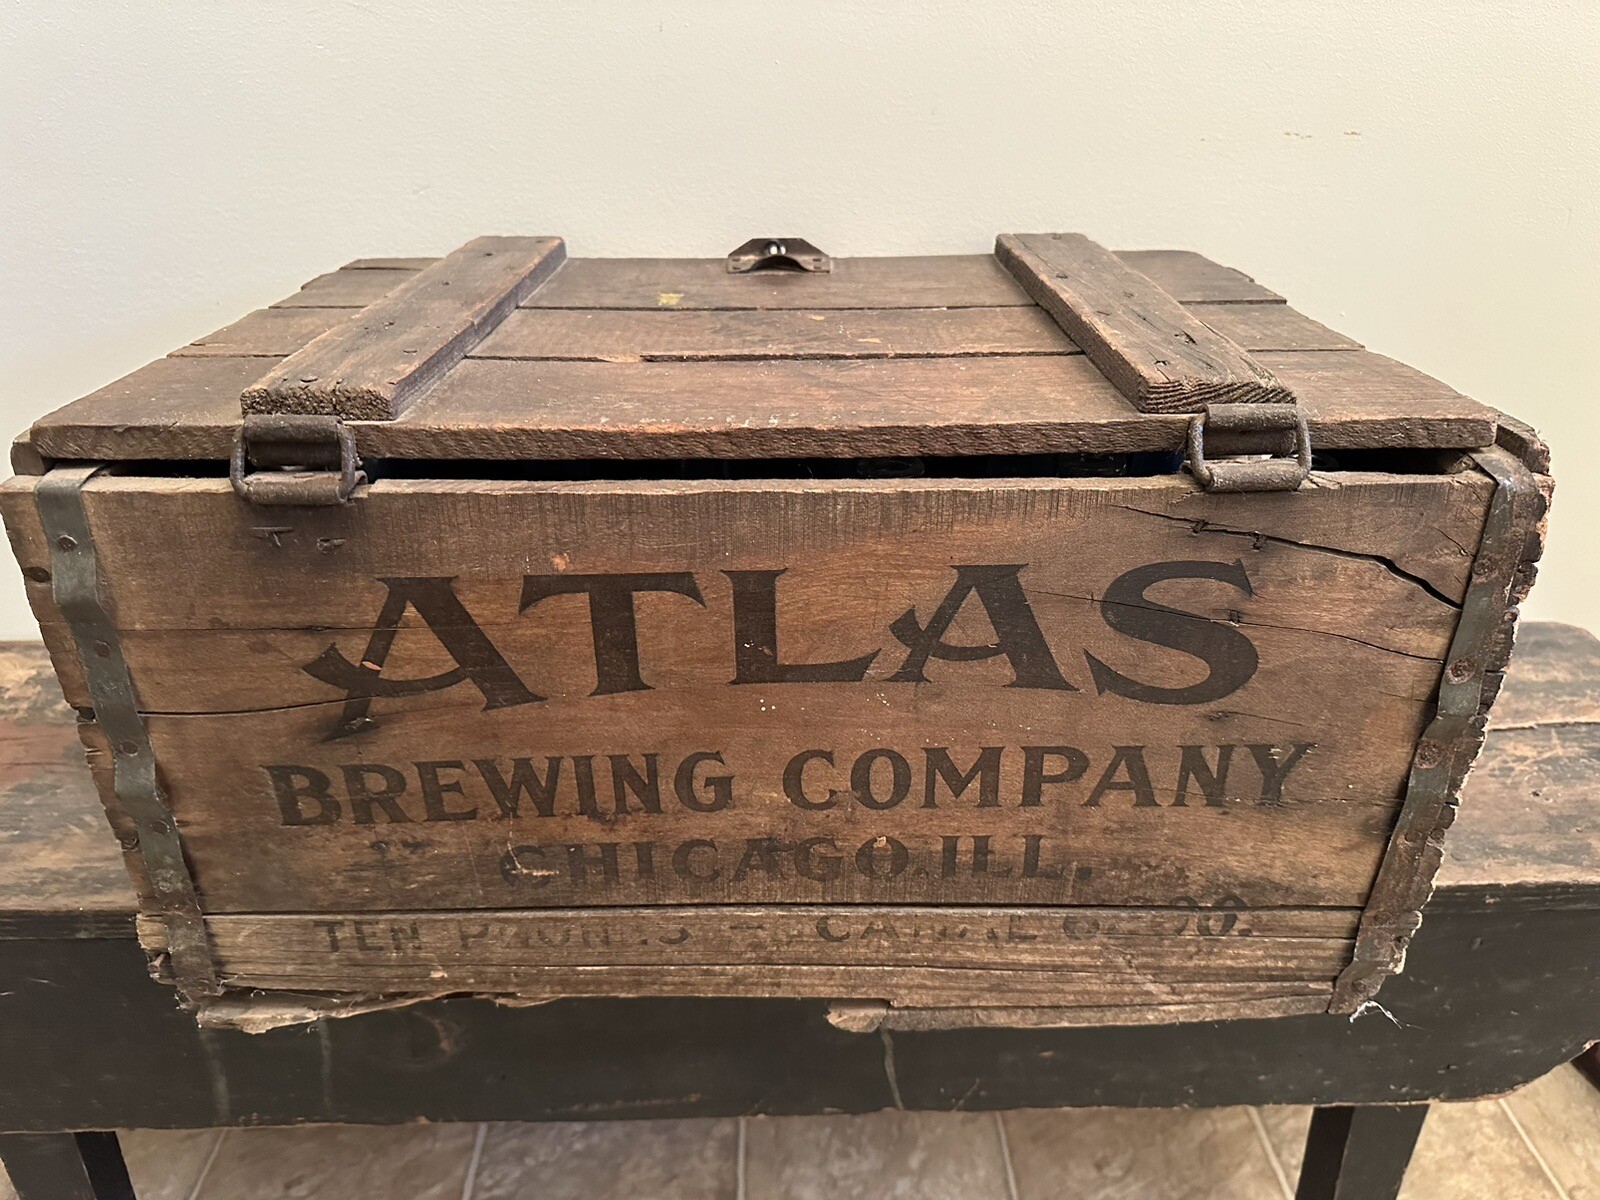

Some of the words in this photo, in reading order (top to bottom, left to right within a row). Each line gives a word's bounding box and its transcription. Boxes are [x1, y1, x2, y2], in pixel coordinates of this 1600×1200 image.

[302, 557, 1259, 743] ATLAS
[260, 750, 735, 827] BREWING
[782, 742, 1318, 811] COMPANY
